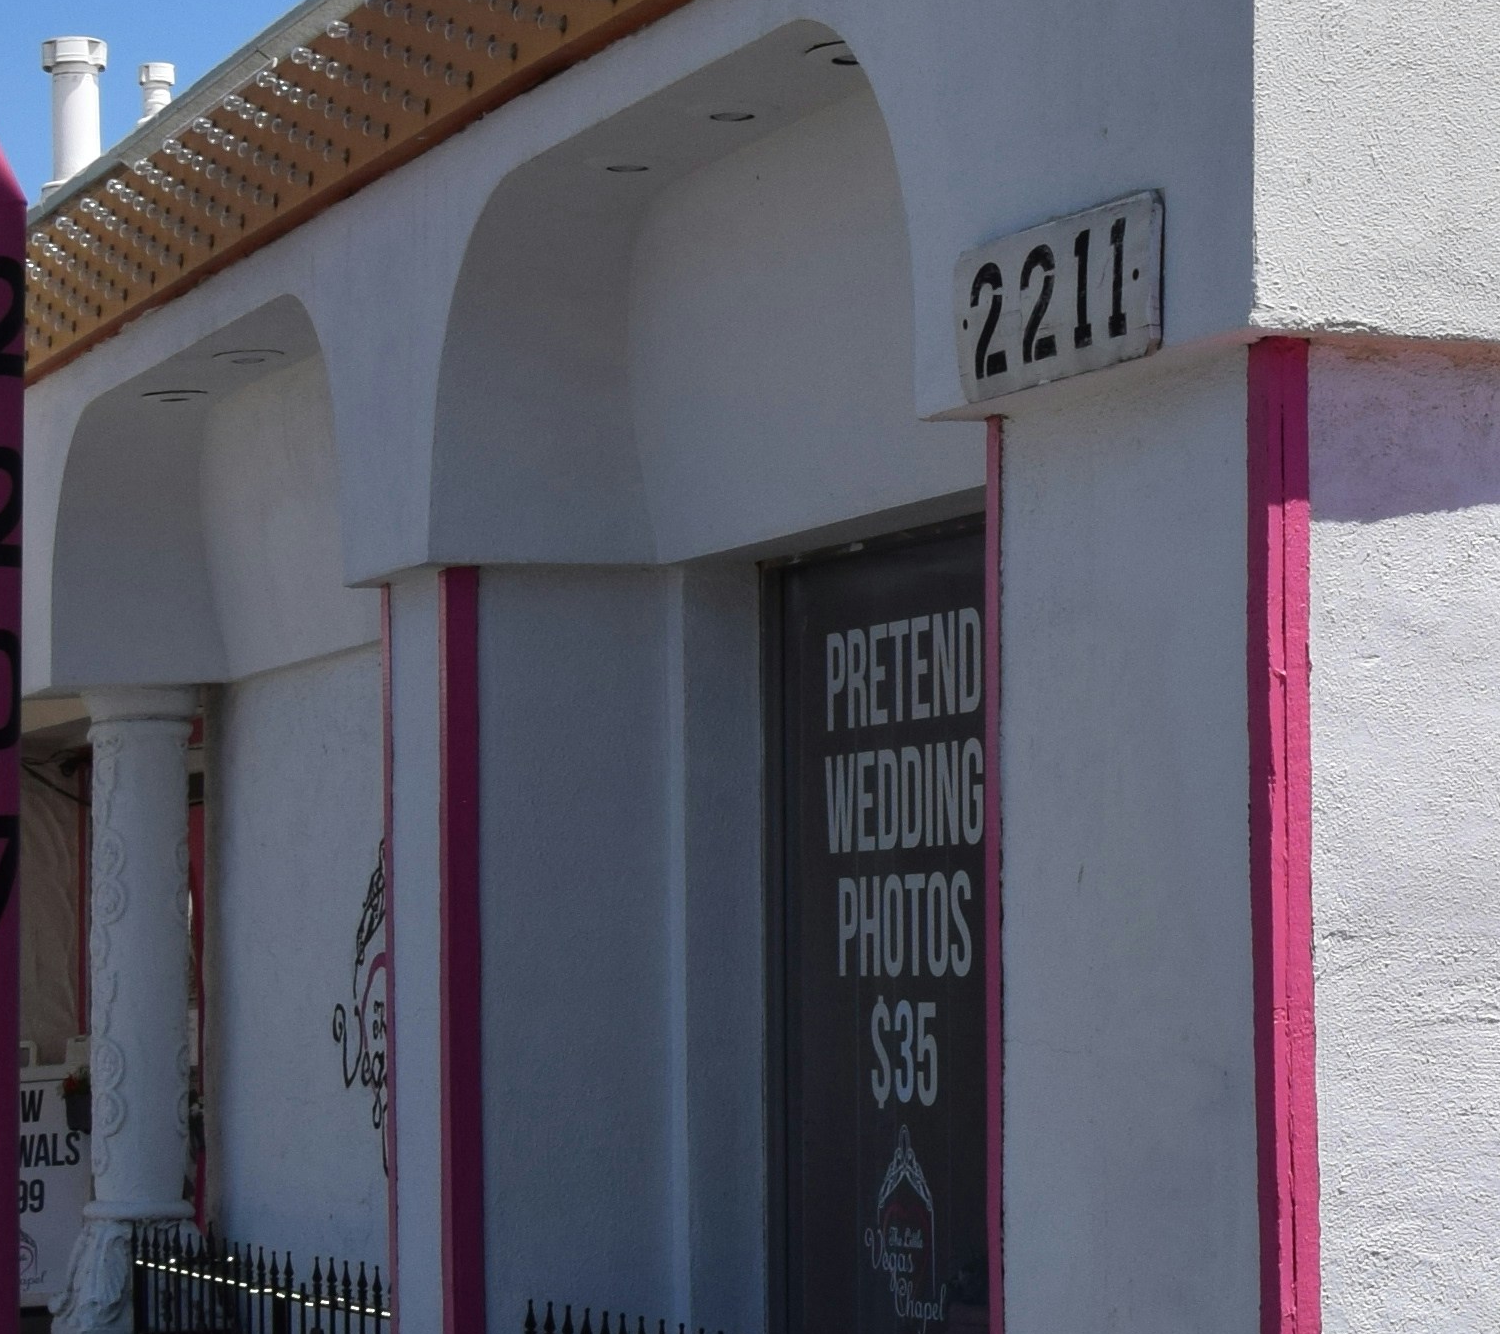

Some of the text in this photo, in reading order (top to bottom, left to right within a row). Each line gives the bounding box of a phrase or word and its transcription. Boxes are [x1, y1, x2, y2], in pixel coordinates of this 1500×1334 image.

[966, 216, 1129, 380] 2211
[826, 607, 982, 732] PRETEND
[825, 737, 984, 854] WEDDING
[838, 869, 972, 978] PHOTOS
[870, 995, 939, 1109] $35
[865, 1228, 915, 1292] Vegas
